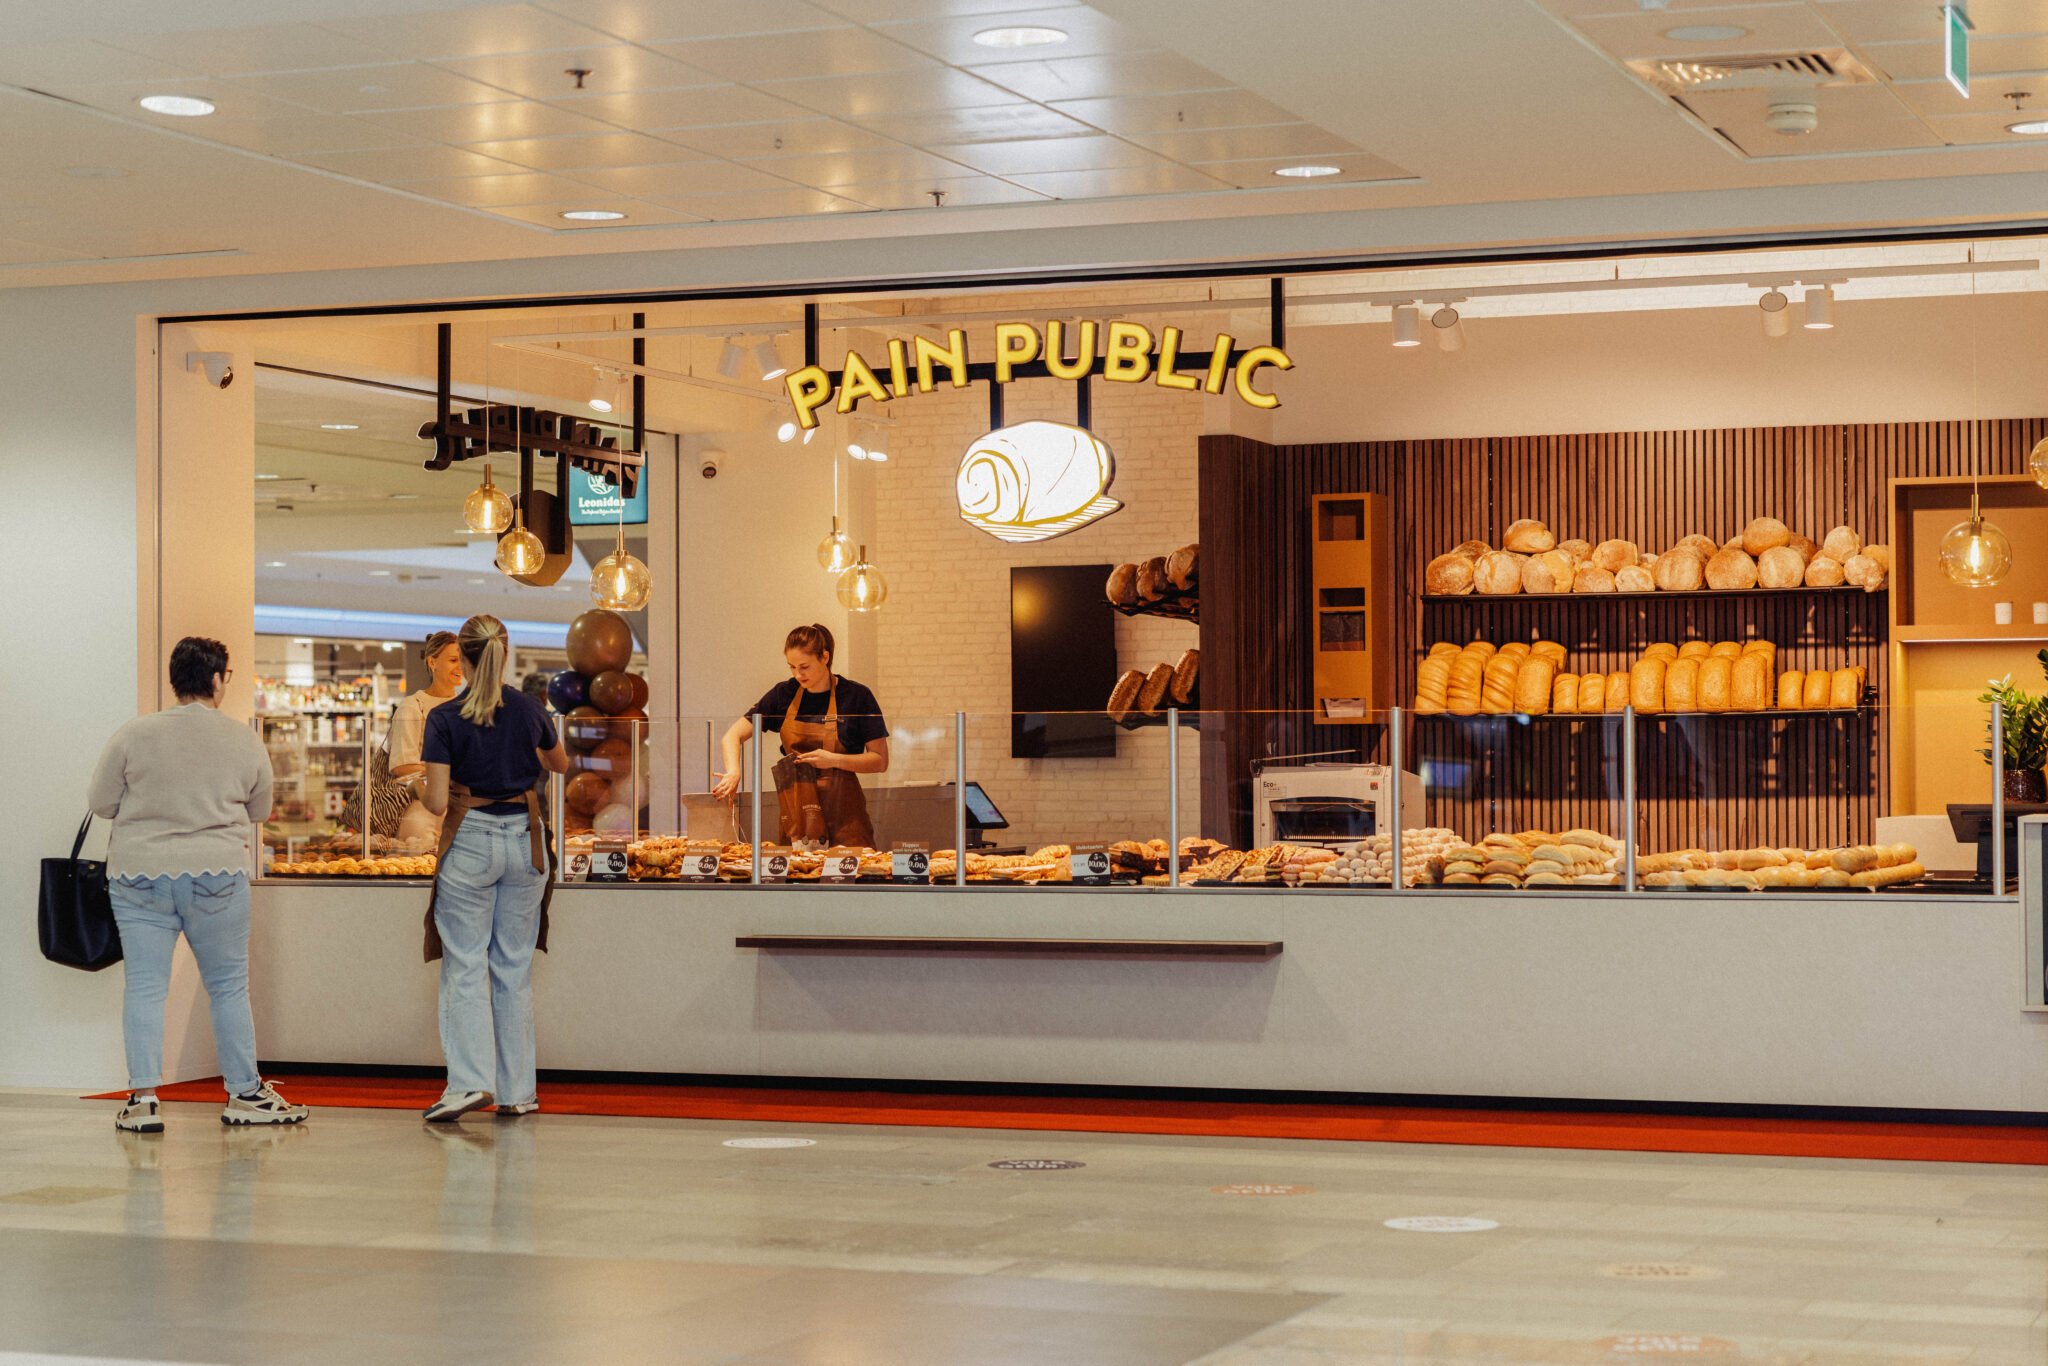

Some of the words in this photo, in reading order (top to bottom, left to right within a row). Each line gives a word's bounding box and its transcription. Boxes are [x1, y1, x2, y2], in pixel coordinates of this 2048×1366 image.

[785, 329, 969, 429] PAIN
[995, 320, 1293, 409] PUBLIC
[578, 496, 626, 508] Leonidas
